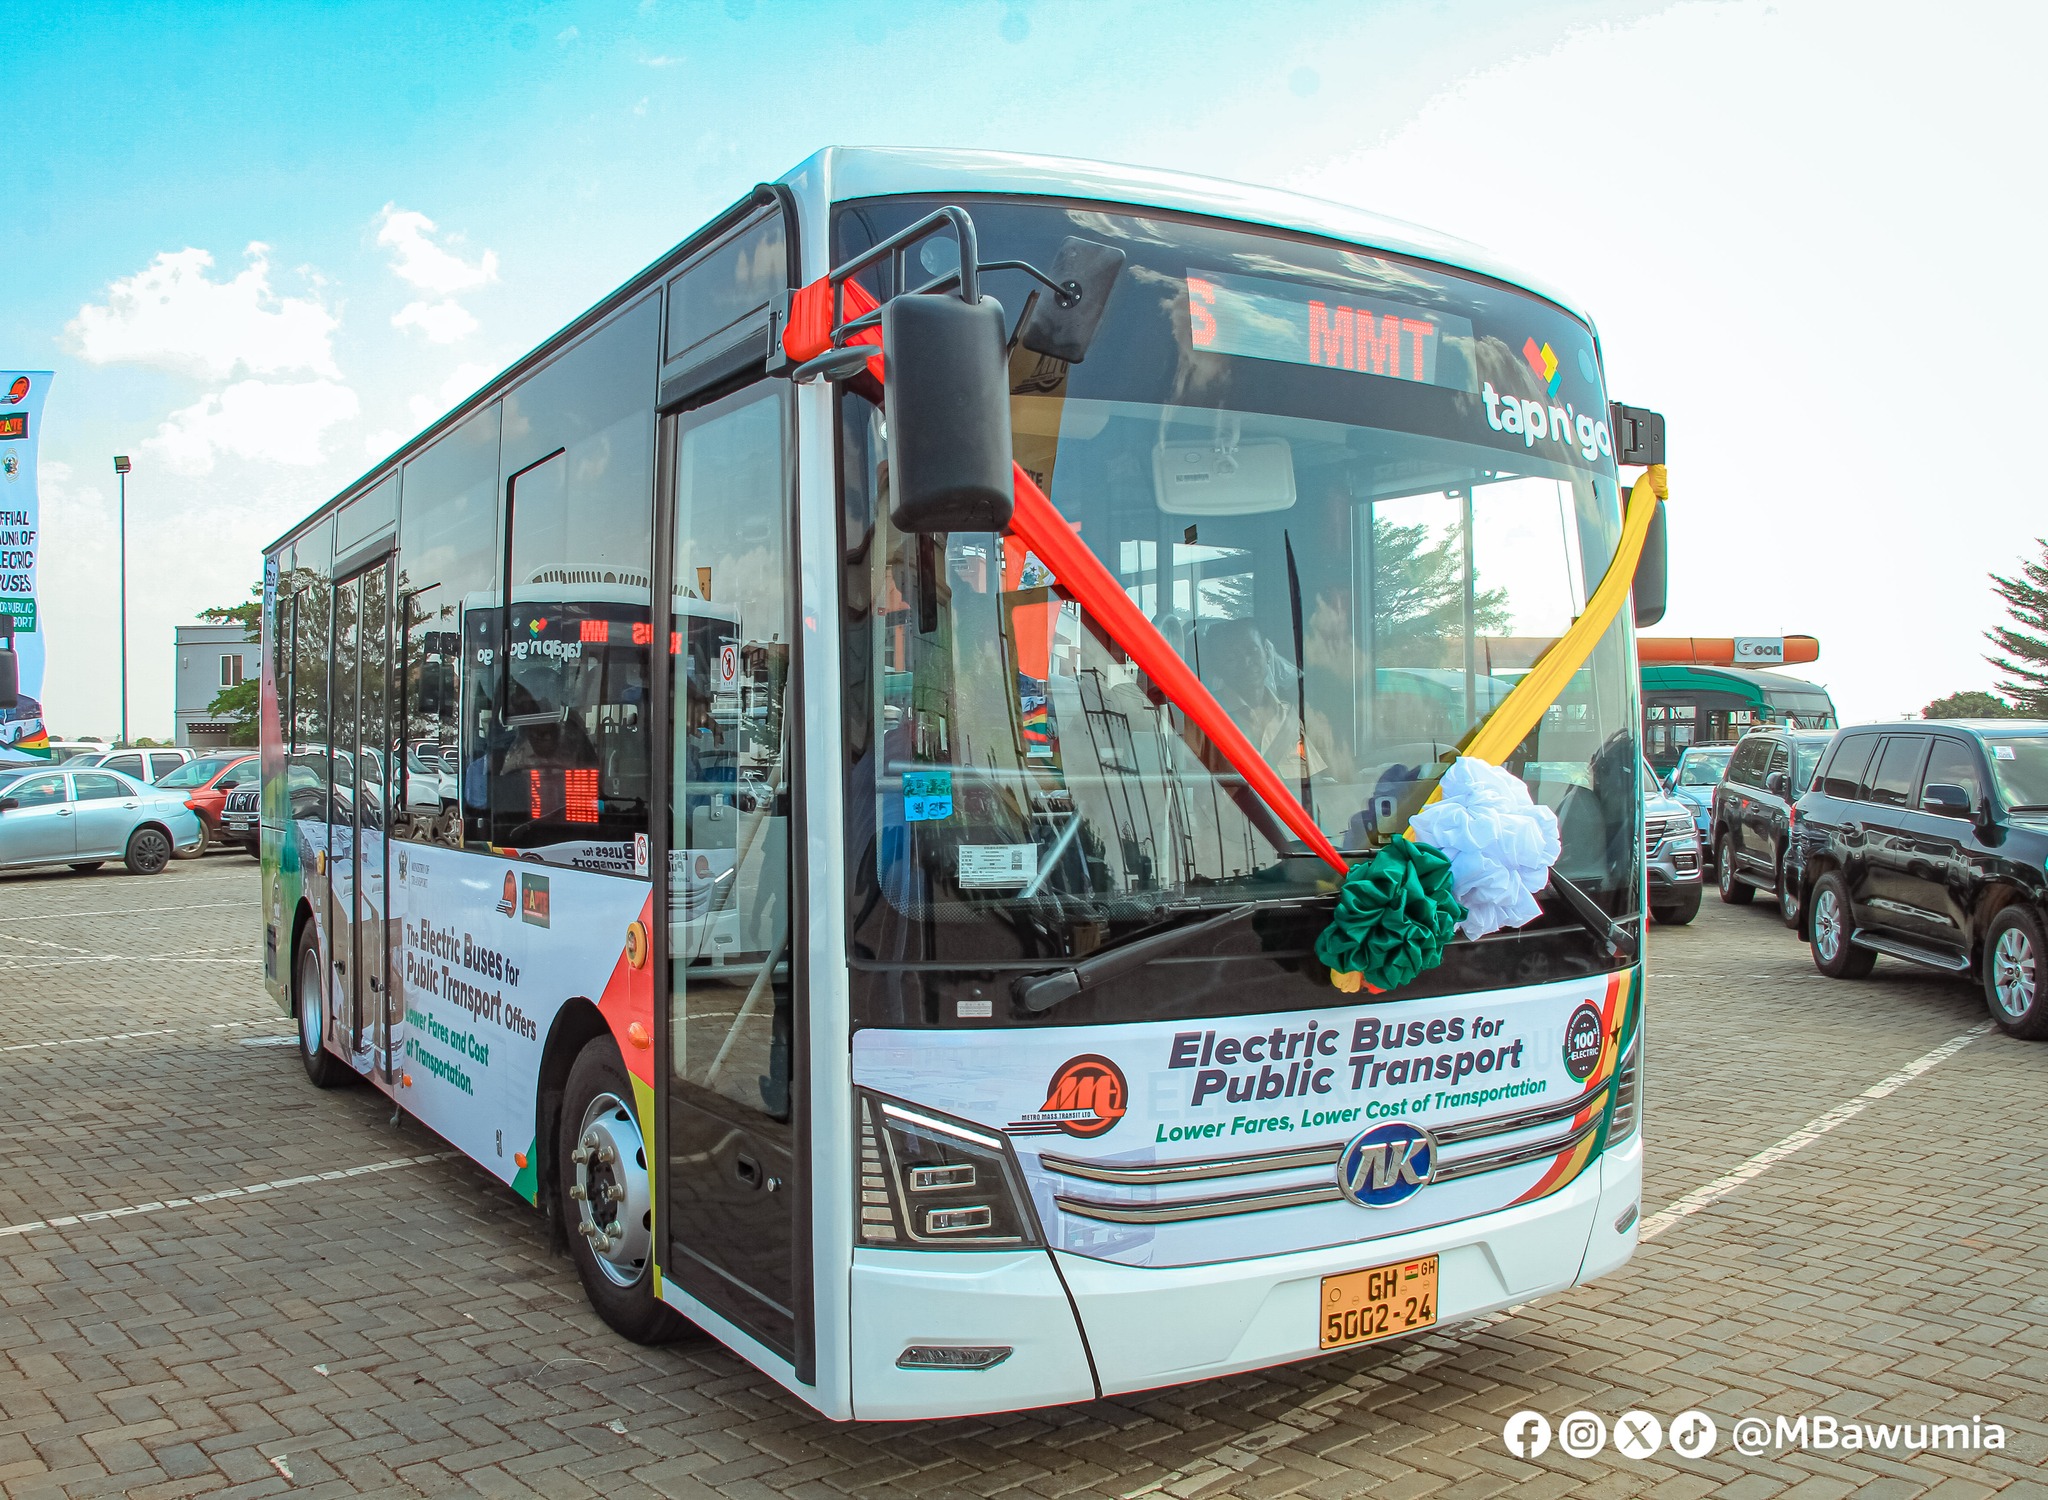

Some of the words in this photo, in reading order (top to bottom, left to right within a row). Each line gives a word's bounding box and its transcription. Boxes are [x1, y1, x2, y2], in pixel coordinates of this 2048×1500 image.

[1308, 300, 1434, 381] MMT
[21, 531, 36, 546] OF
[0, 574, 32, 592] USES
[14, 616, 35, 628] PORT
[1754, 645, 1782, 656] GOIL
[407, 923, 419, 948] The
[421, 918, 460, 965] Electric
[463, 932, 503, 981] Buses
[505, 958, 520, 987] for
[407, 951, 439, 996] Public
[441, 965, 502, 1025] Transport
[505, 1003, 537, 1041] Offers
[405, 1001, 426, 1031] Lower
[428, 1012, 449, 1044] Fares
[450, 1031, 467, 1054] and
[468, 1033, 489, 1067] Cost
[1168, 1019, 1340, 1069] Electric
[1350, 1017, 1465, 1053] Buses
[1471, 1016, 1504, 1039] for
[1571, 1047, 1598, 1061] ELECTRIC
[406, 1037, 414, 1058] of
[415, 1039, 474, 1096] Transportation.
[1191, 1058, 1335, 1107] Public
[1348, 1039, 1523, 1090] Transport
[1155, 1122, 1226, 1143] Lower
[1230, 1115, 1295, 1136] Fares,
[1301, 1107, 1361, 1128] Lower
[1366, 1098, 1408, 1119] Cost
[1411, 1093, 1431, 1113] of
[1434, 1078, 1547, 1110] Transportation
[1368, 1269, 1398, 1302] GH
[1421, 1260, 1435, 1276] GH
[1327, 1293, 1431, 1344] 5002-24
